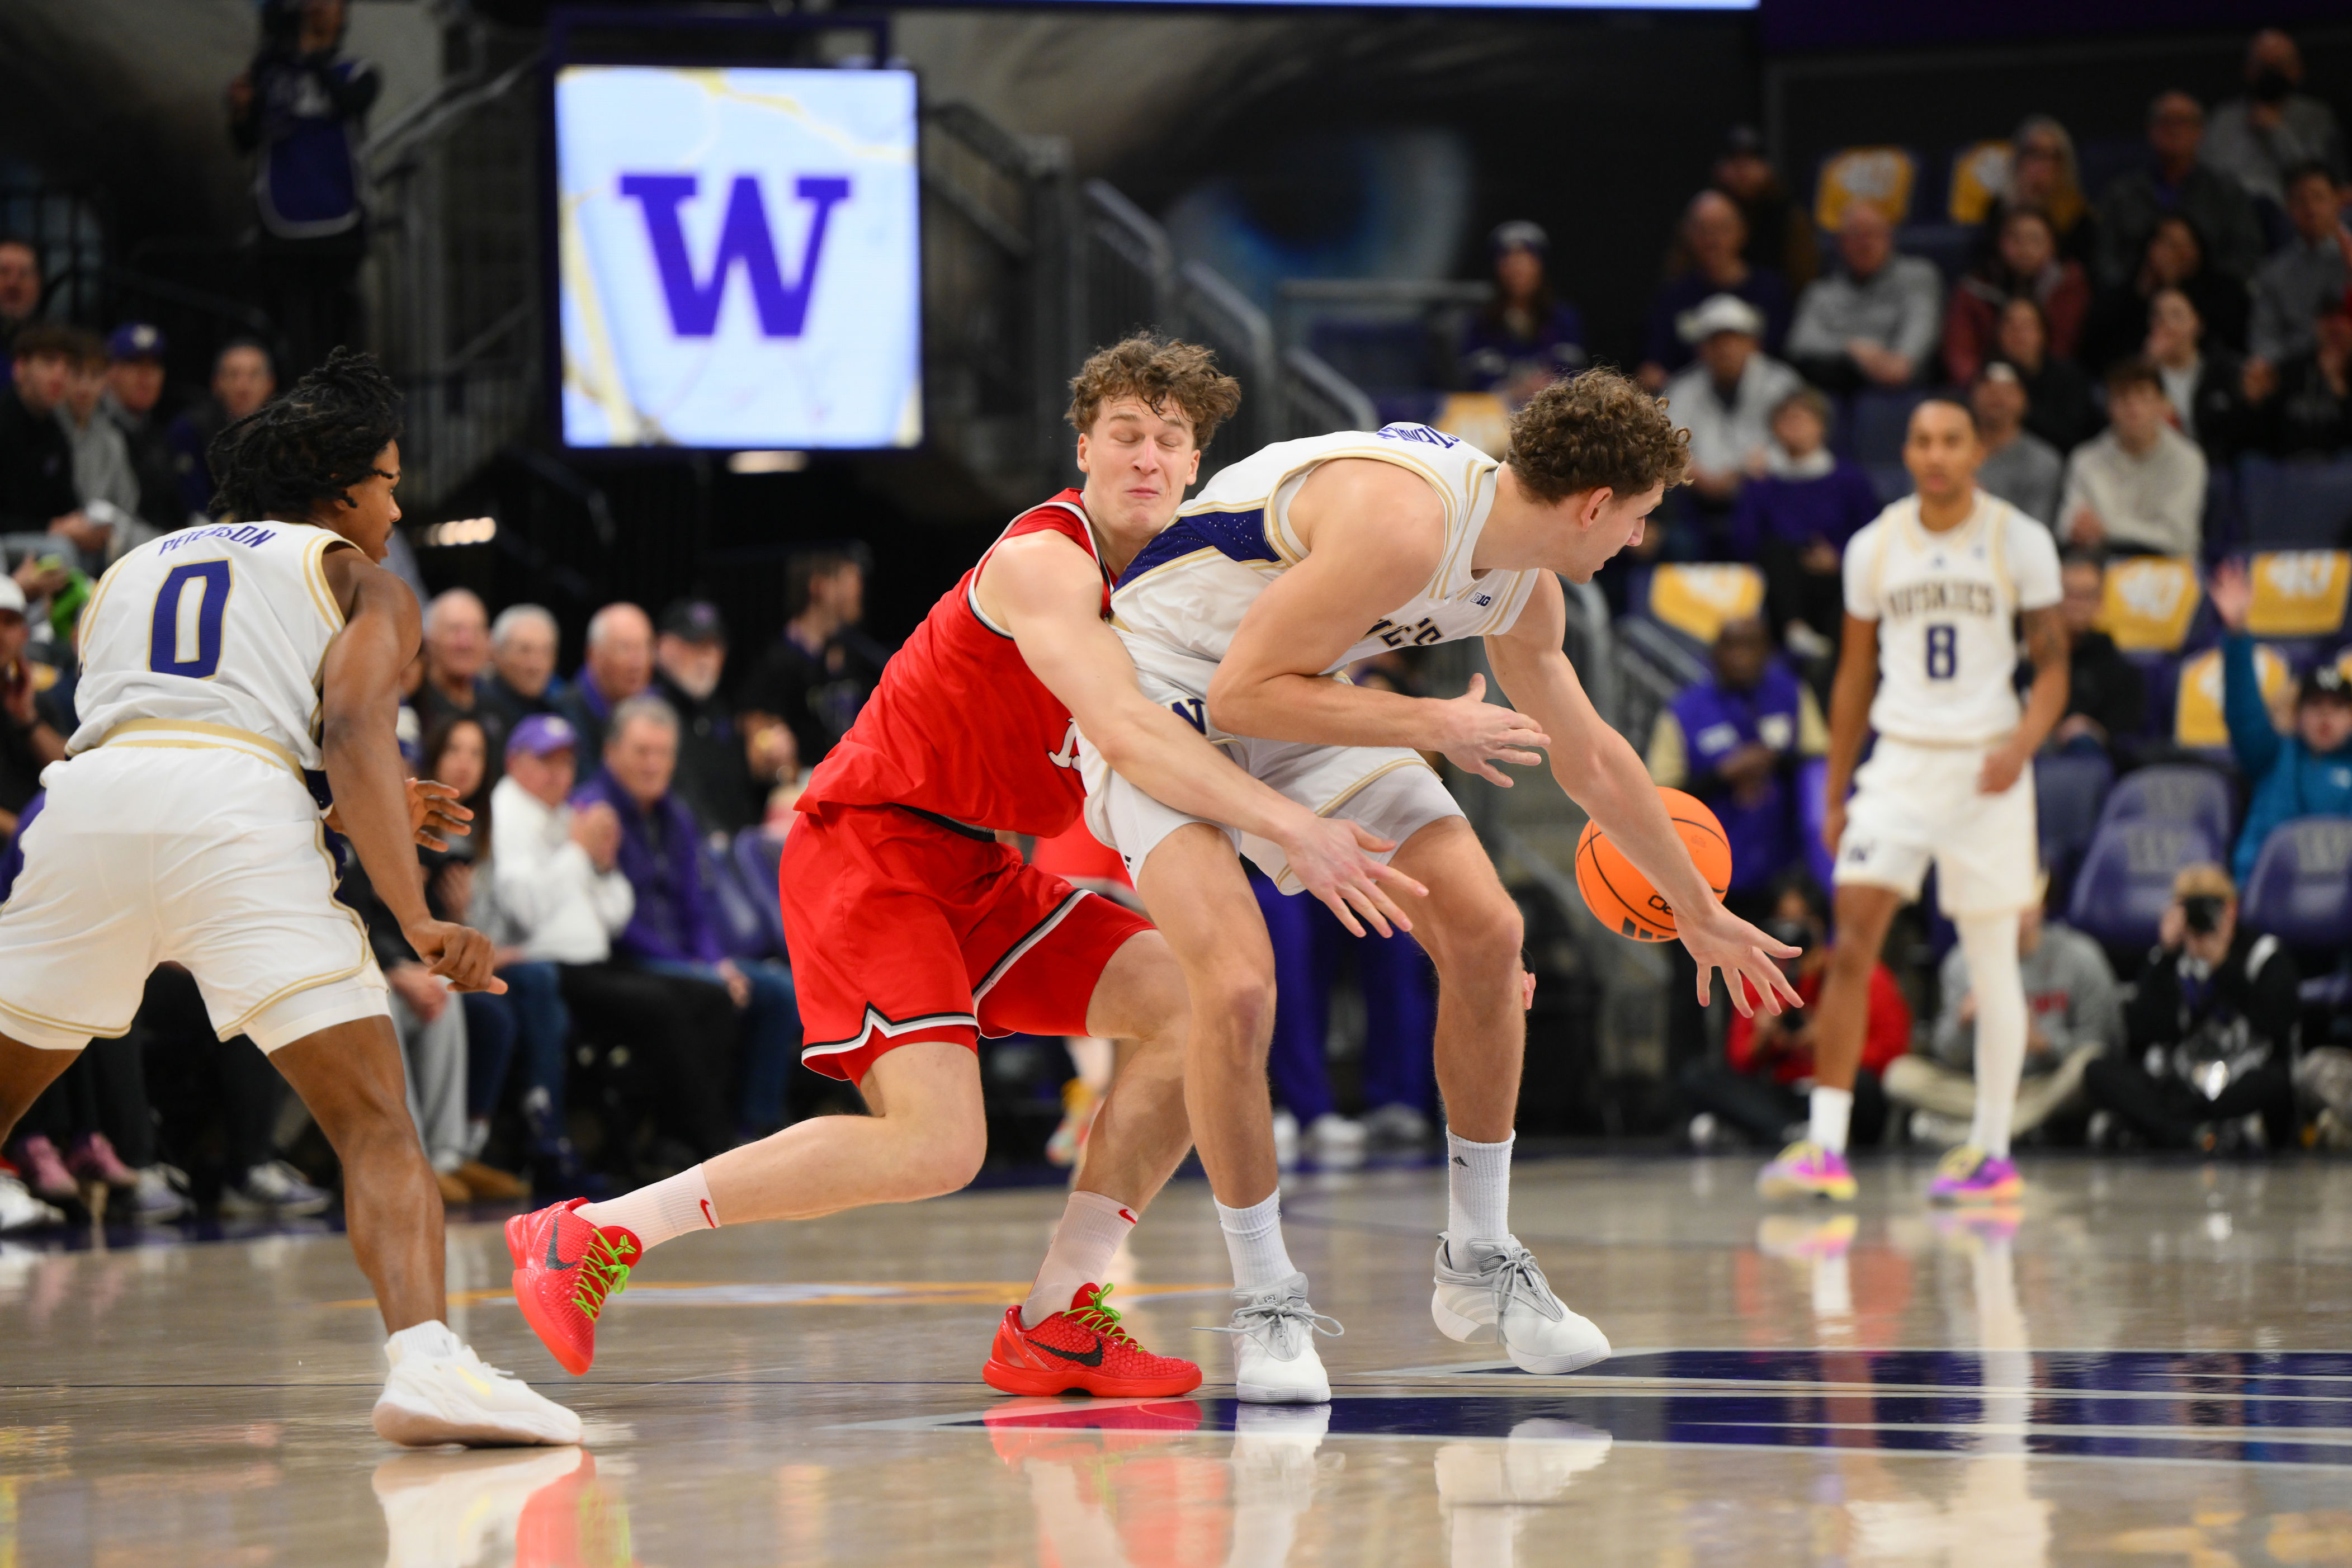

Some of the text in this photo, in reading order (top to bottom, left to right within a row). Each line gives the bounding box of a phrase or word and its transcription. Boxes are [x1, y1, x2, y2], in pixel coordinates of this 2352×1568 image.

[621, 174, 850, 338] W
[158, 525, 277, 556] PETERSON
[145, 556, 235, 682] 0
[1926, 623, 1956, 679] 8
